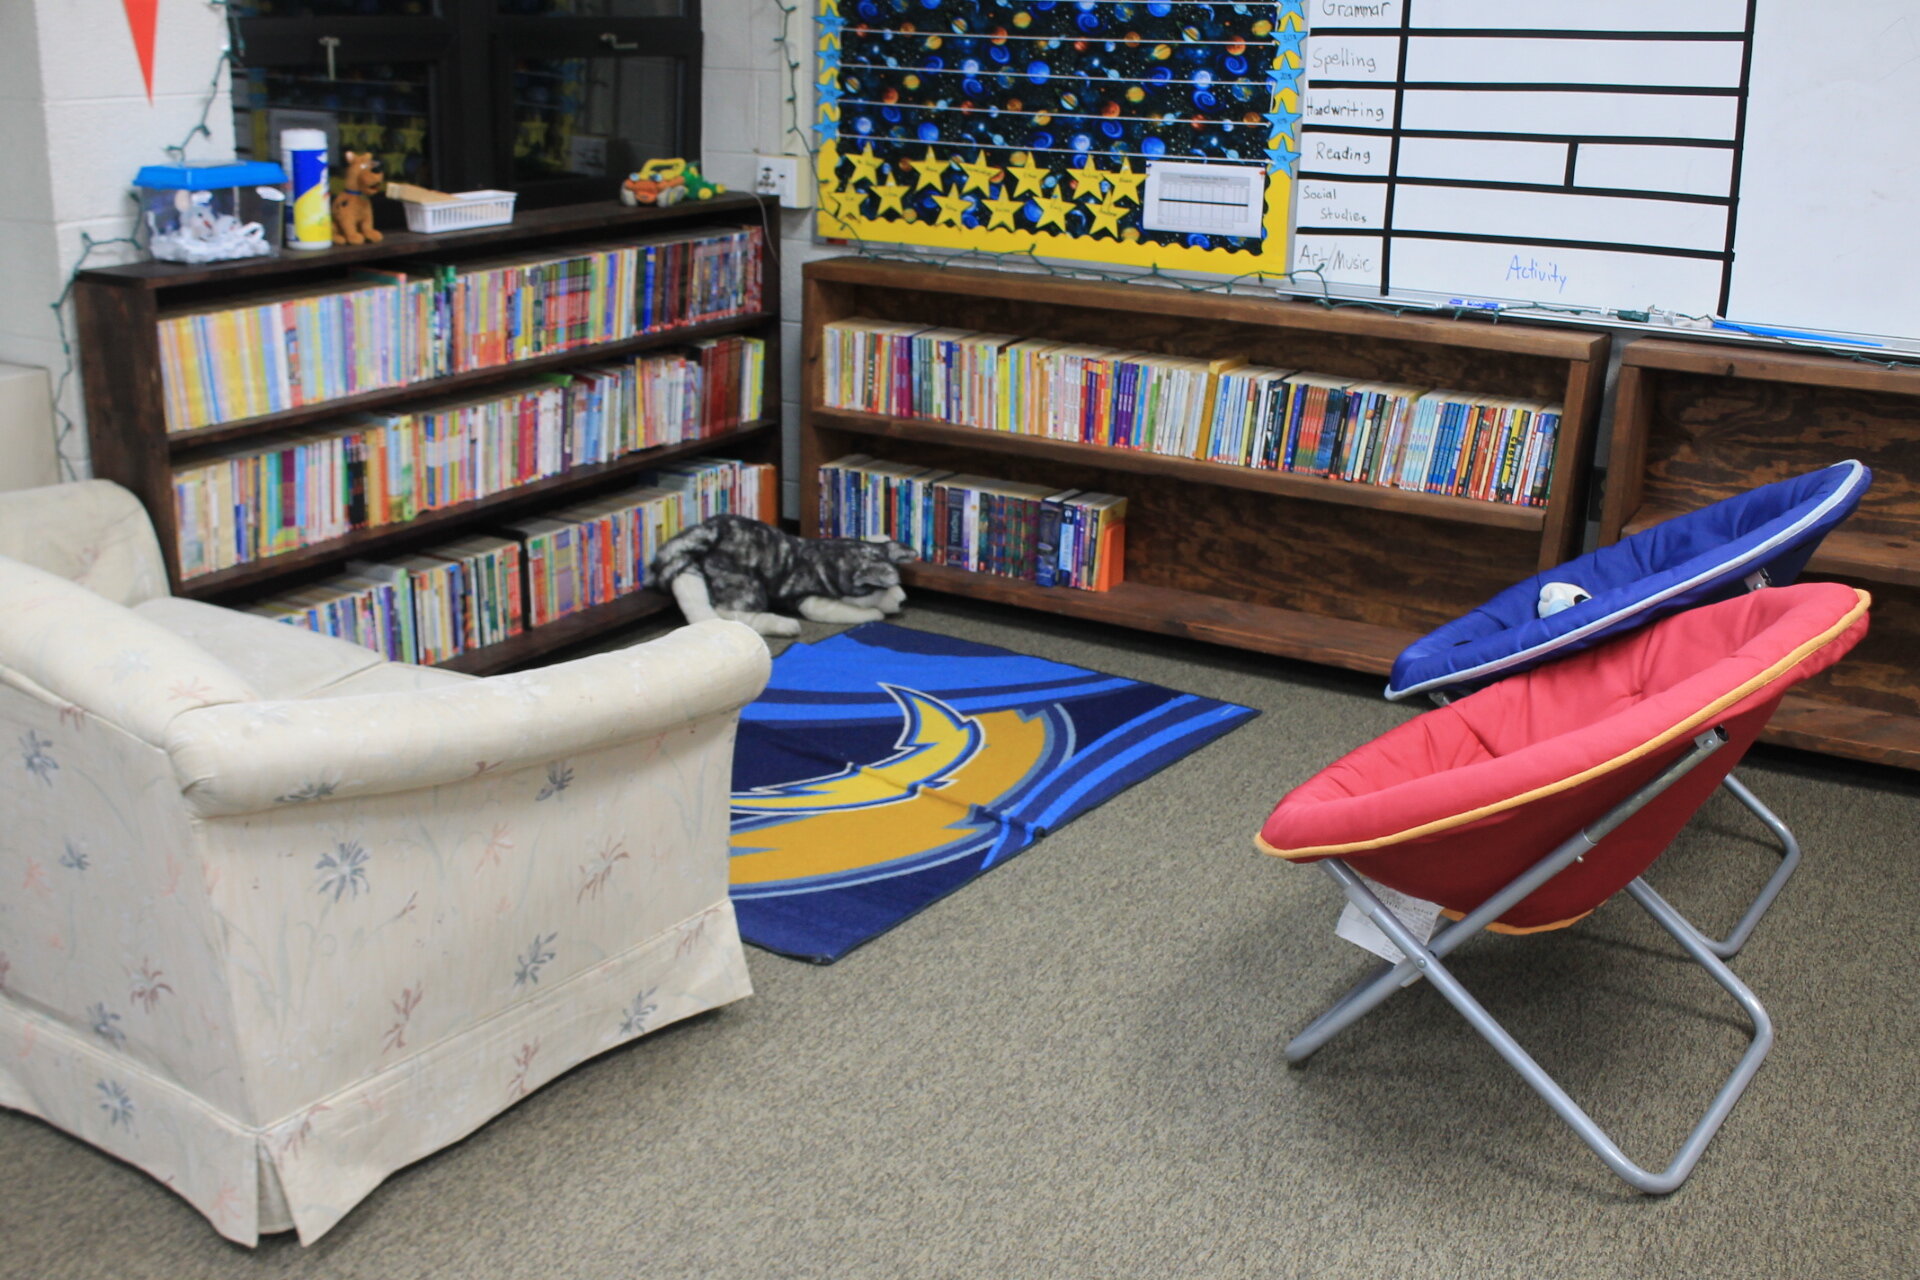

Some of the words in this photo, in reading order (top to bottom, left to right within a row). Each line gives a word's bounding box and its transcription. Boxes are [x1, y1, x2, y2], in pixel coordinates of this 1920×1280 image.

[1322, 0, 1391, 17] Grammar
[1312, 47, 1377, 74] Spelling
[1306, 96, 1385, 122] Handwriting
[1315, 142, 1371, 164] Reading
[1303, 185, 1337, 200] Social
[1320, 207, 1367, 223] Studies
[1505, 254, 1567, 294] Activity
